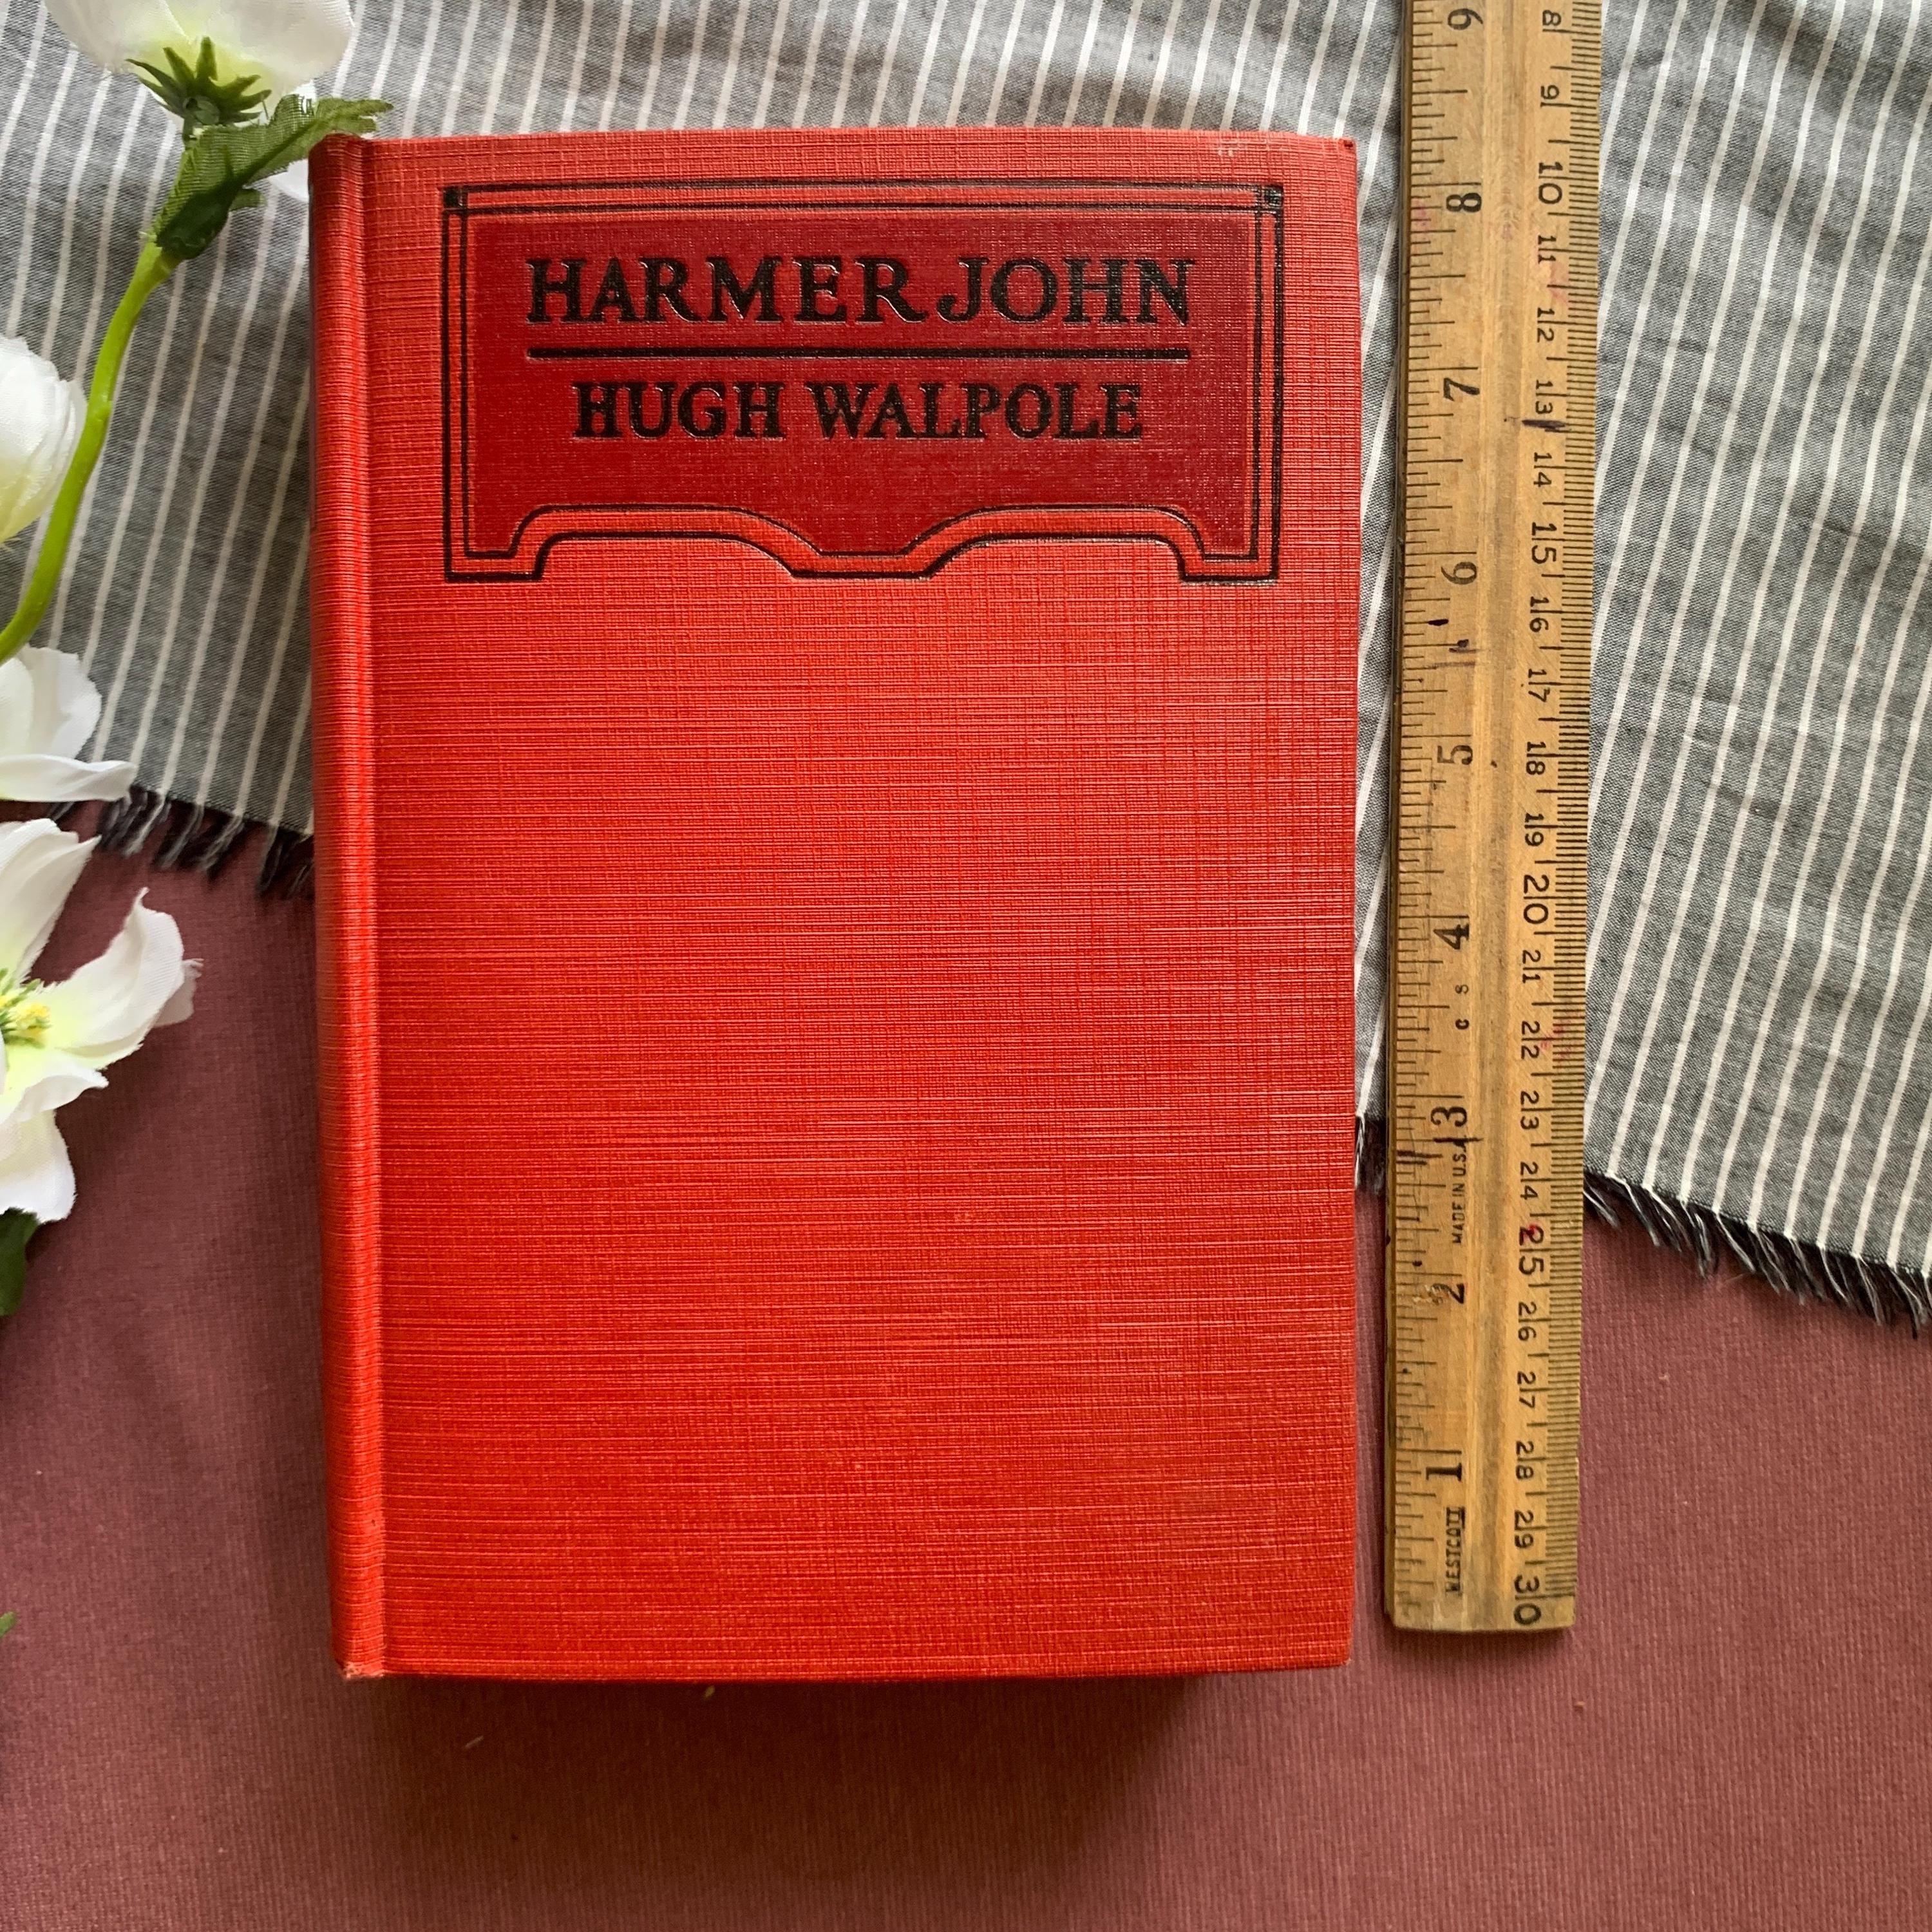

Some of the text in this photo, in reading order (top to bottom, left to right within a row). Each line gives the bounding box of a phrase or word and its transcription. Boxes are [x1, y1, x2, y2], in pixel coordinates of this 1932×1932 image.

[1447, 8, 1483, 31] 9
[1542, 10, 1562, 27] 8
[1540, 84, 1560, 101] 9
[1538, 161, 1563, 205] 10
[1446, 193, 1482, 213] 8
[1537, 234, 1557, 265] 11
[526, 257, 1197, 325] HARMER JOHN
[1537, 307, 1555, 343] 12
[1443, 377, 1480, 402] 7
[1535, 379, 1553, 415] 13
[573, 381, 1144, 440] HUGH WALPOLE
[1533, 451, 1553, 488] 14
[1531, 522, 1557, 564] 15
[1441, 561, 1478, 585] 6
[1530, 596, 1549, 632] 16
[1528, 668, 1551, 703] 17
[1437, 744, 1473, 766] 5
[1526, 741, 1546, 775] 18
[1524, 813, 1544, 847] 19
[1523, 875, 1549, 924] 20
[1433, 923, 1470, 950] 4
[1522, 949, 1542, 984] 21
[1520, 1021, 1540, 1059] 22
[1430, 1106, 1467, 1128] 3
[1520, 1090, 1540, 1130] 23
[1452, 1183, 1466, 1197] IN
[1520, 1161, 1539, 1200] 24
[1452, 1202, 1466, 1244] MADE
[1518, 1225, 1545, 1275] 25
[1425, 1282, 1465, 1305] 2
[1518, 1301, 1537, 1341] 26
[1517, 1371, 1537, 1409] 27
[1425, 1463, 1463, 1482] 1
[1515, 1440, 1535, 1480] 28
[1514, 1510, 1534, 1549] 29
[1444, 1506, 1461, 1595] WESTCOTT
[1513, 1575, 1542, 1626] 30
